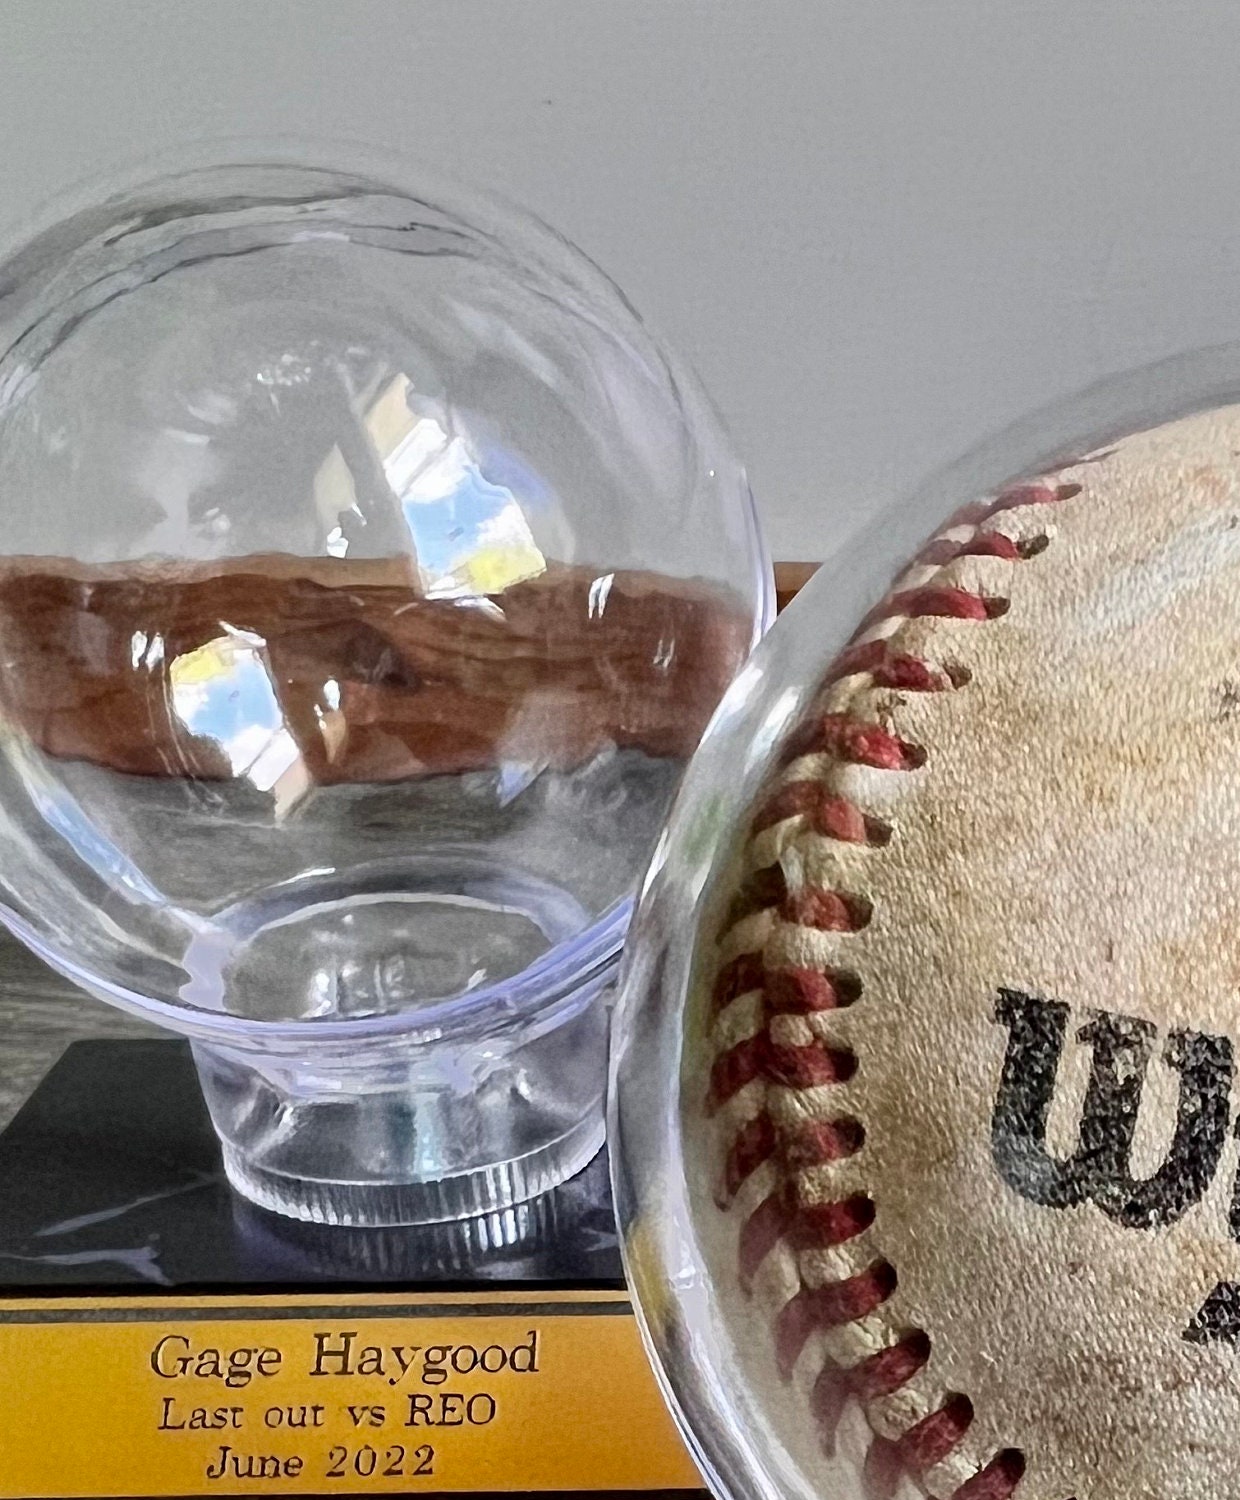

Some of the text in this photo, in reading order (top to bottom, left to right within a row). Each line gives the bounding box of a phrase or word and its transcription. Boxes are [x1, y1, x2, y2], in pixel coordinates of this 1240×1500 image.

[150, 1330, 540, 1387] Gage Haygood
[157, 1393, 497, 1430] Last out vs REO
[206, 1444, 436, 1479] June 2022
